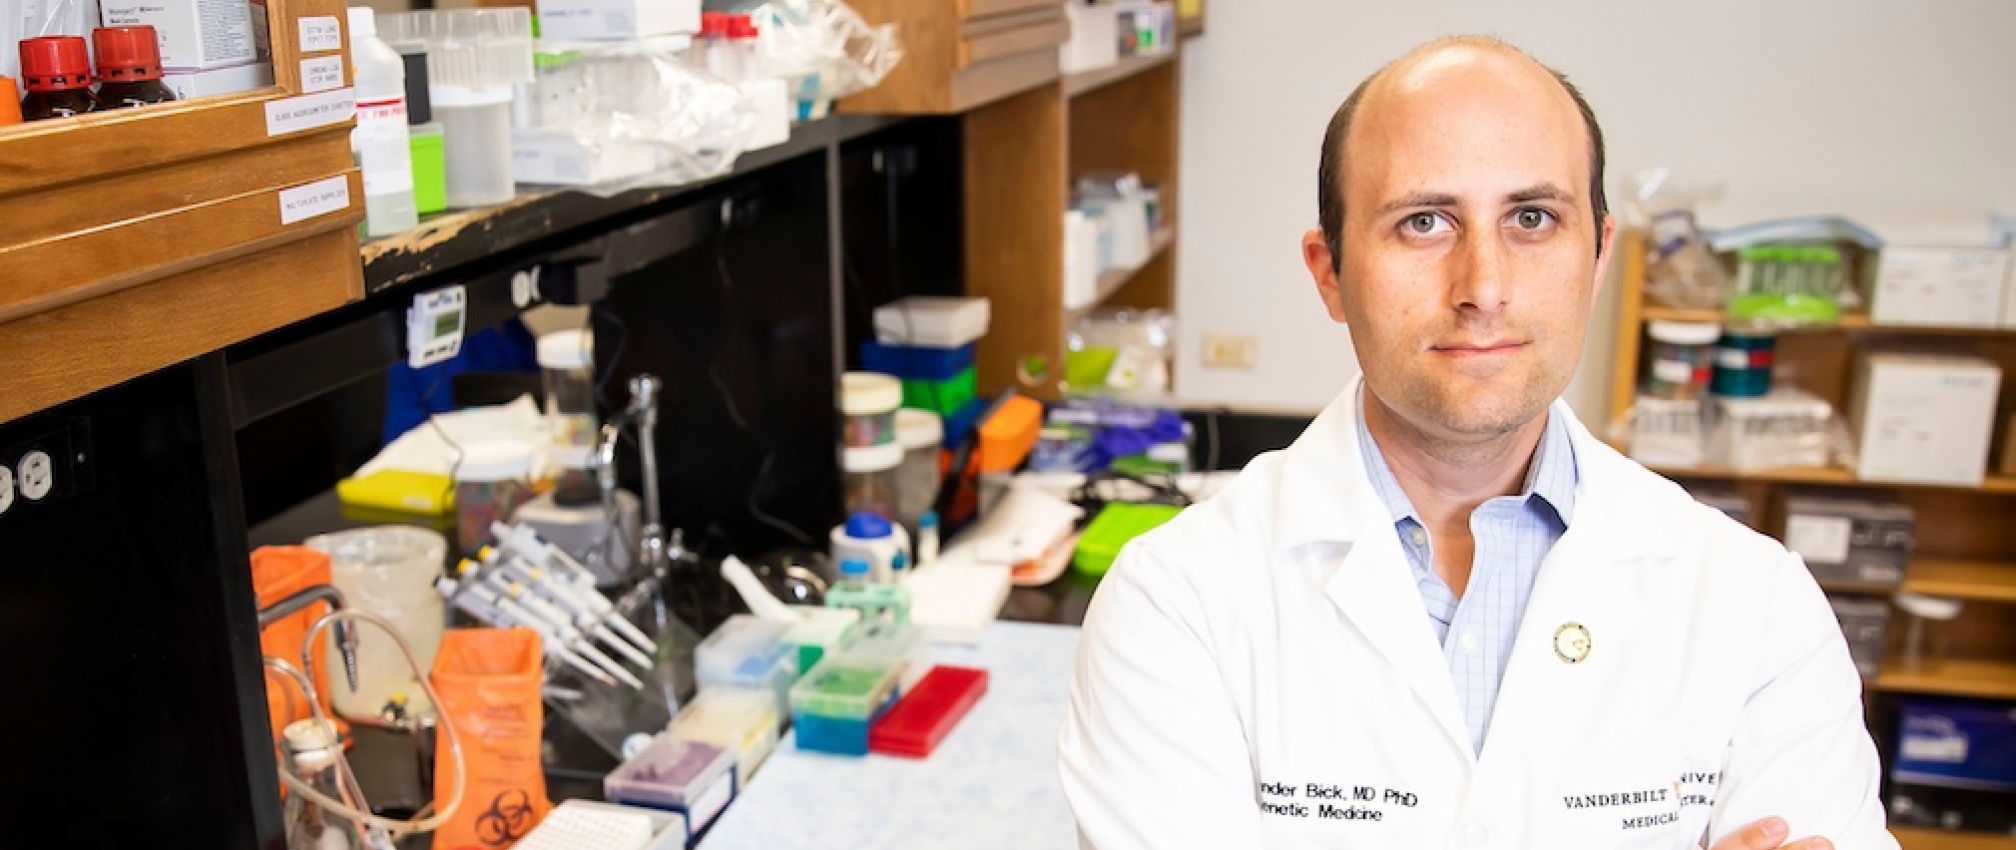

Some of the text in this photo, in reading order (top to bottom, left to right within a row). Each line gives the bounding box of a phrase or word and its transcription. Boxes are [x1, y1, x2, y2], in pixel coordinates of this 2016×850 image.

[1261, 781, 1297, 797] nder
[1353, 786, 1376, 801] MD
[1384, 788, 1418, 807] PhD
[1563, 788, 1667, 809] VANDERBILT
[1318, 804, 1383, 821] Medicine
[1622, 810, 1679, 830] MEDICAL
